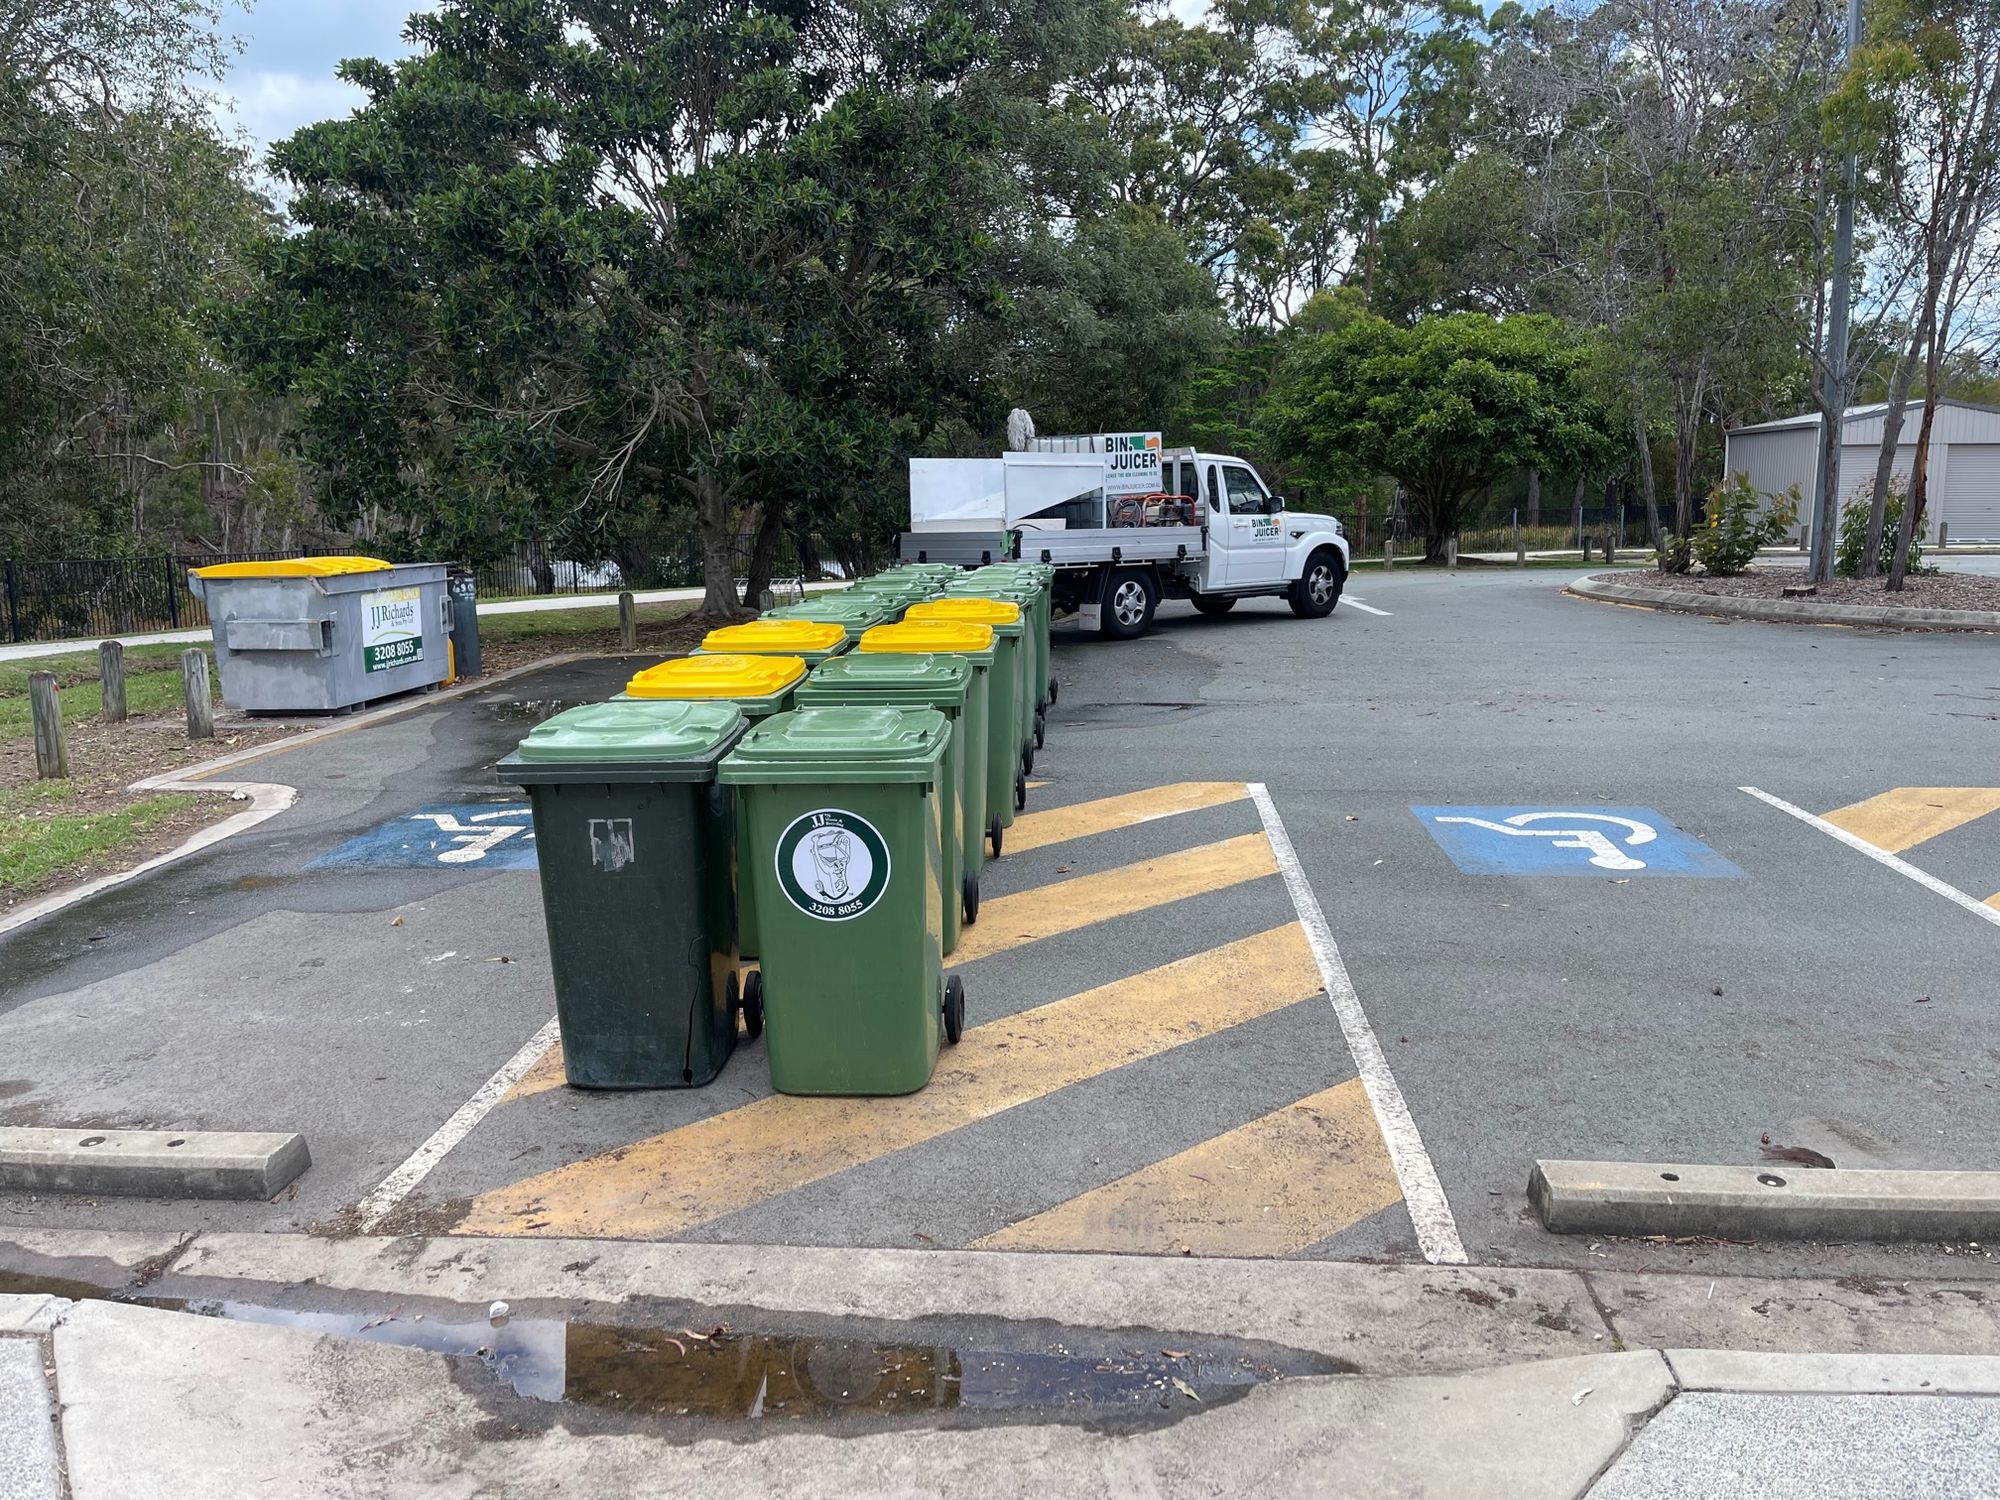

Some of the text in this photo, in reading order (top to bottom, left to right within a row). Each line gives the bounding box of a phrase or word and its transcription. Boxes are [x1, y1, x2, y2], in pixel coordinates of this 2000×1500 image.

[1110, 452, 1157, 470] JUICER
[1254, 527, 1279, 537] JUICER
[374, 640, 414, 661] 3208 8055
[808, 899, 863, 916] 3208 8055
